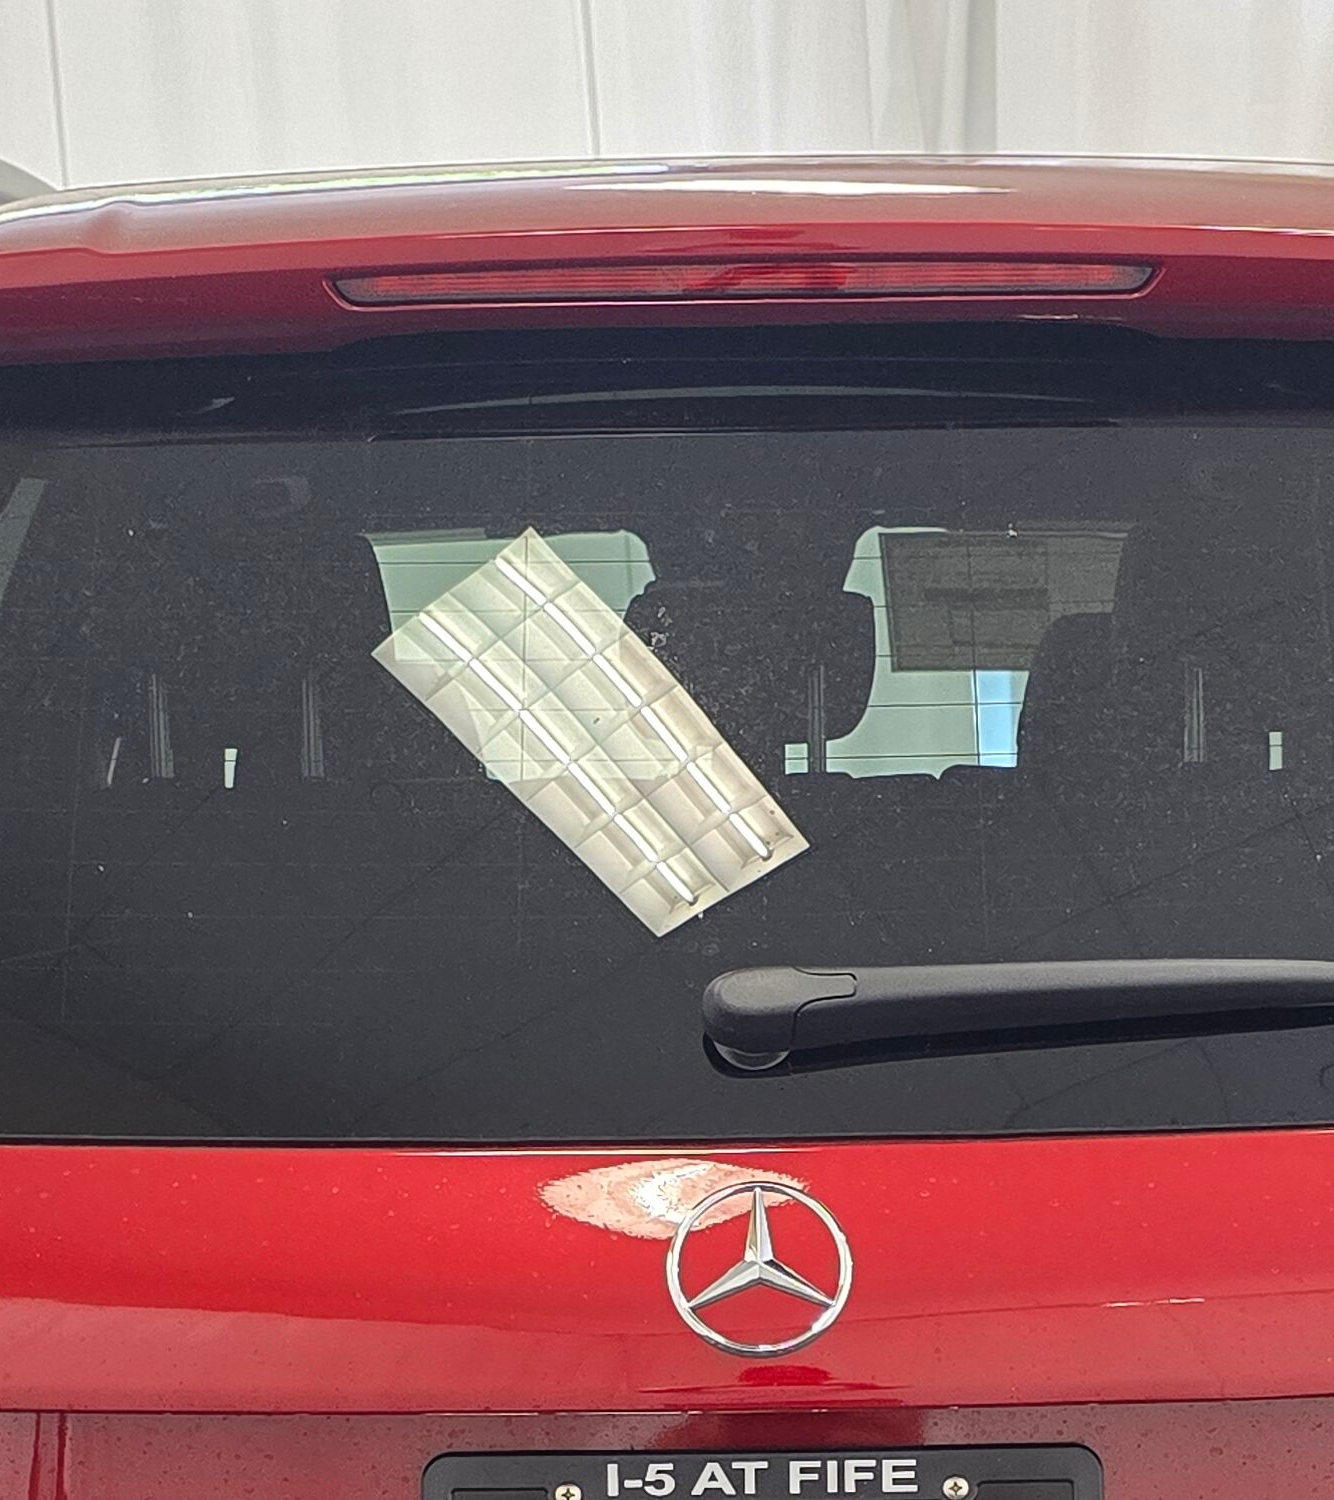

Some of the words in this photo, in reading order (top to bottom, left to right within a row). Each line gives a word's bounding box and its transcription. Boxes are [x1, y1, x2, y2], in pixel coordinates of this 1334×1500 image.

[606, 1462, 676, 1497] I-5
[690, 1460, 769, 1496] AT
[789, 1459, 919, 1495] FIFE
